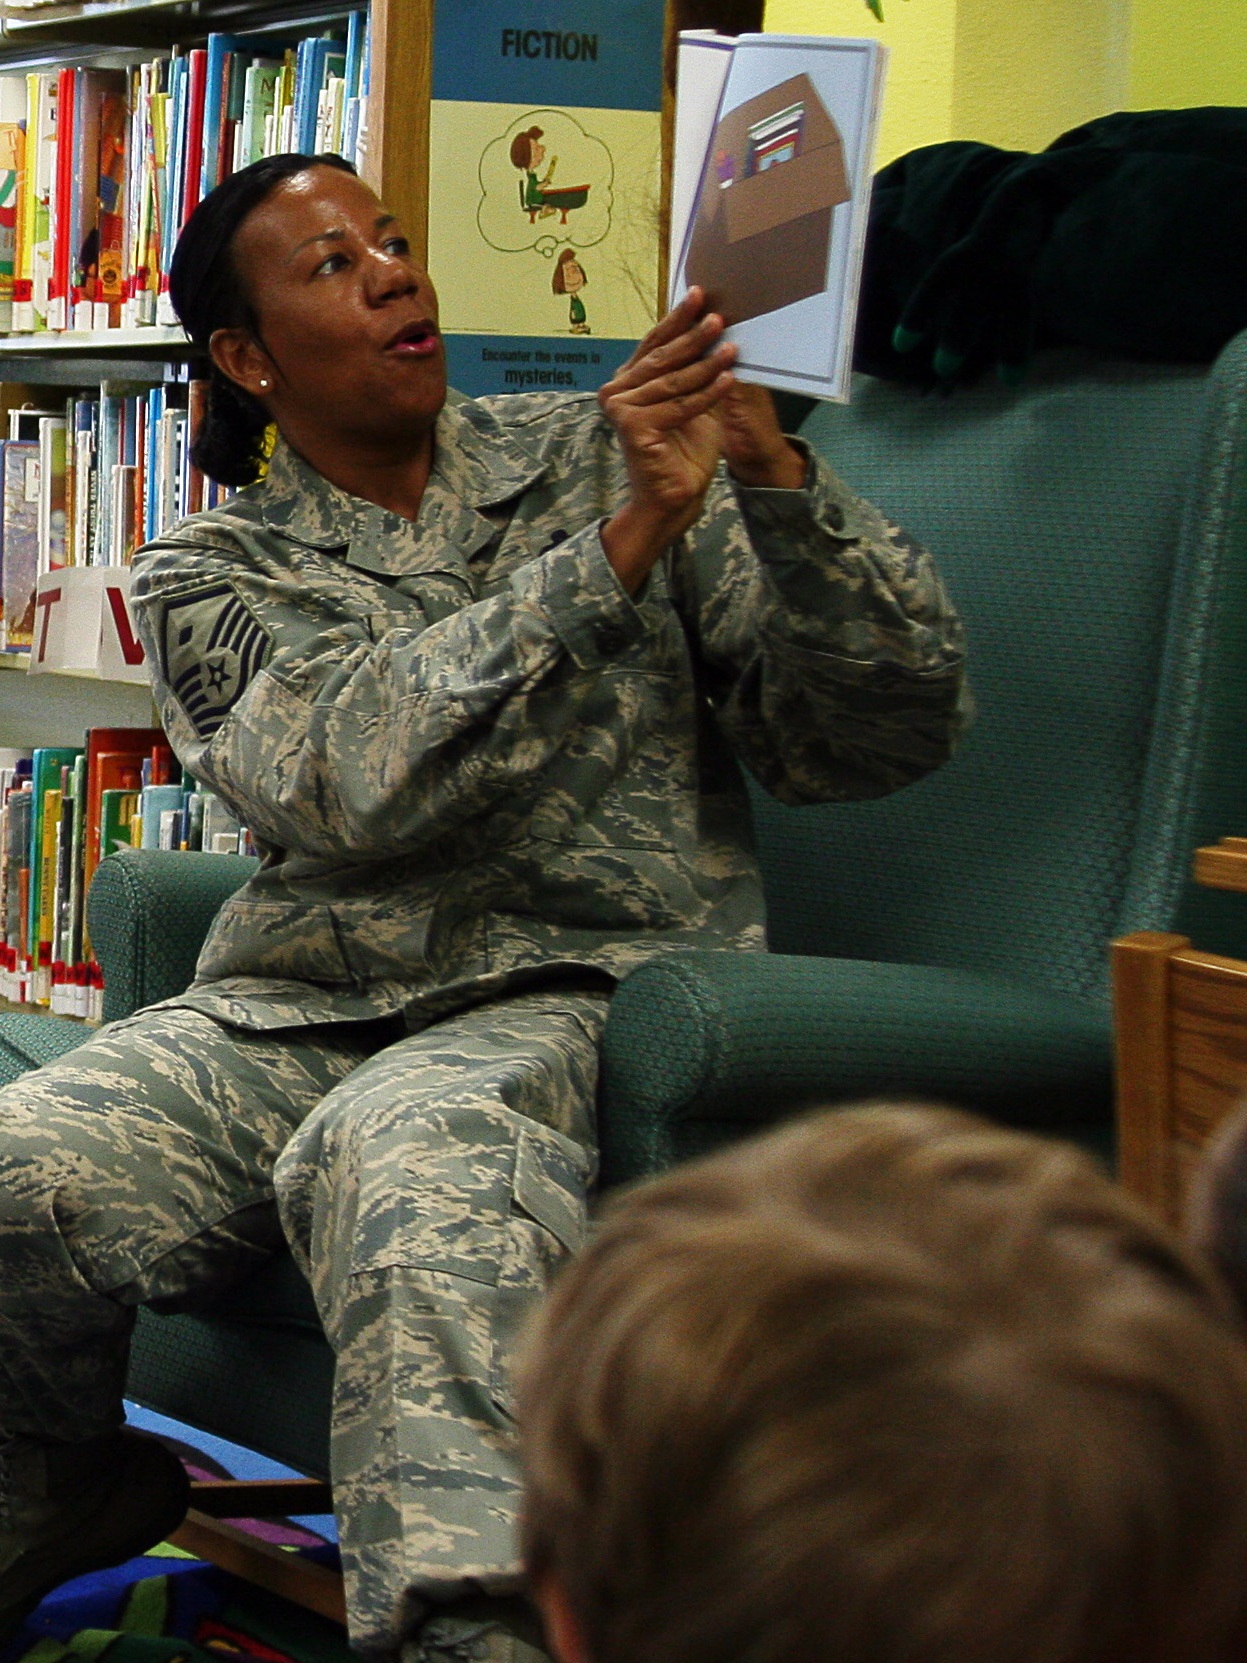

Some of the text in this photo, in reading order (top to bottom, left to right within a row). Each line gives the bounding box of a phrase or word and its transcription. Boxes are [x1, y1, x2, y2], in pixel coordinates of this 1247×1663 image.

[501, 29, 598, 61] FICTION
[481, 348, 600, 365] Encounter the events in
[504, 367, 577, 388] mysteries,
[37, 587, 61, 663] T
